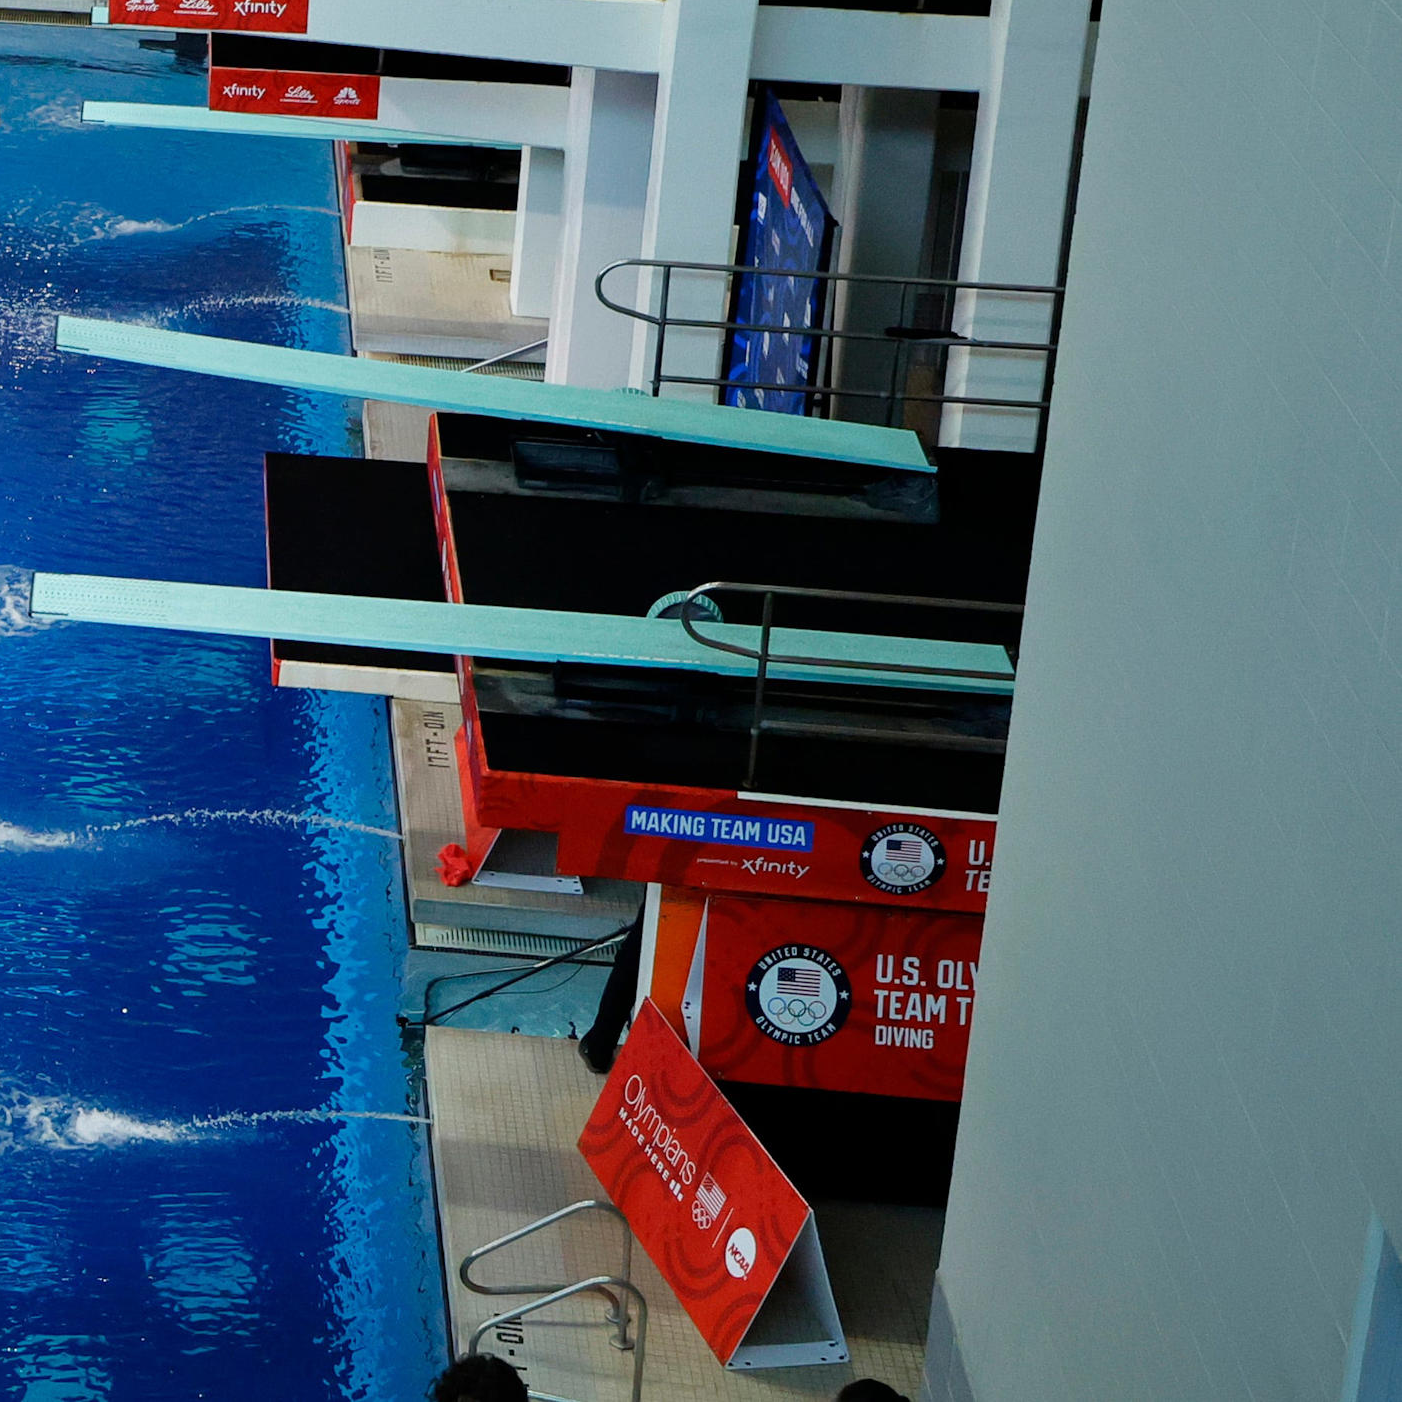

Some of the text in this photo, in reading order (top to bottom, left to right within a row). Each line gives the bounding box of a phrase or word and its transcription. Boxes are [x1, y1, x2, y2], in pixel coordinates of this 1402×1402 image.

[125, 0, 160, 12] Sports
[223, 83, 315, 100] xfinity Lilly
[630, 809, 807, 847] MAKING TEAM USA
[741, 856, 810, 879] xfinity
[757, 946, 842, 977] UNITED STATES
[875, 953, 927, 987] U.S.
[873, 989, 947, 1025] TEAM
[755, 1015, 838, 1044] OLYMPIC TEAM
[875, 1025, 934, 1050] DIVING
[618, 1107, 670, 1182] MADE HERE
[624, 1074, 697, 1186] Olympians
[728, 1242, 750, 1271] NCAA
